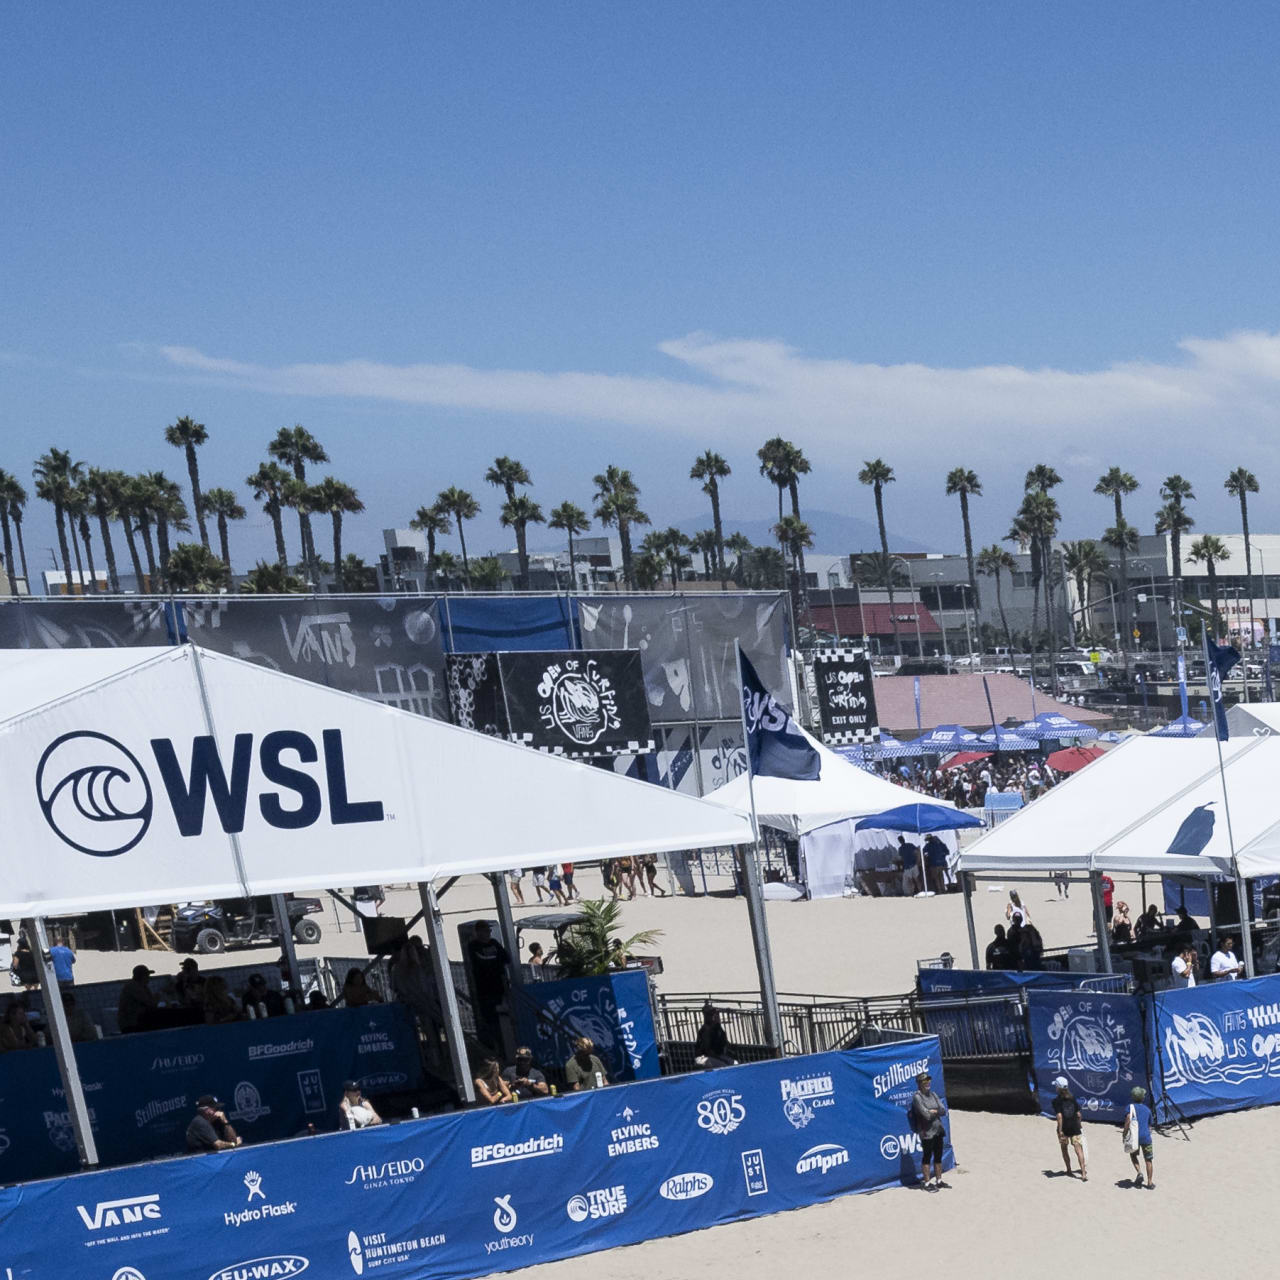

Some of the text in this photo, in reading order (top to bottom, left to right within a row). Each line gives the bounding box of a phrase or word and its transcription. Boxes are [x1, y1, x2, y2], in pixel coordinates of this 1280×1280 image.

[280, 612, 356, 668] VANS
[566, 660, 579, 670] OF
[825, 670, 864, 690] US OPEN
[832, 714, 867, 725] EXIT ONLY
[931, 731, 955, 741] VANS
[150, 729, 384, 837] WSL
[1079, 1001, 1092, 1012] OF
[248, 1038, 314, 1057] BFGoodrich
[1225, 1038, 1247, 1059] US
[873, 1057, 929, 1098] Stillhouse
[780, 1076, 833, 1101] PACIFICO
[136, 1095, 187, 1128] Stillhouse
[697, 1095, 746, 1129] 805
[1080, 1097, 1114, 1111] 2022
[611, 1123, 651, 1142] FLYING
[471, 1134, 563, 1163] BFGoodrich
[607, 1136, 660, 1157] EMBERS
[345, 1158, 424, 1185] SHISEIDO
[796, 1149, 850, 1174] ampm
[364, 1176, 415, 1190] GINZA TOKYO
[666, 1174, 708, 1198] Ralphs
[587, 1185, 626, 1203] TRUE
[76, 1194, 162, 1230] VANS
[224, 1208, 261, 1228] Hydro
[589, 1199, 627, 1219] SURF
[363, 1232, 386, 1245] VISIT
[365, 1233, 446, 1258] HUNTINGTON BEACH
[484, 1233, 535, 1255] youtheory
